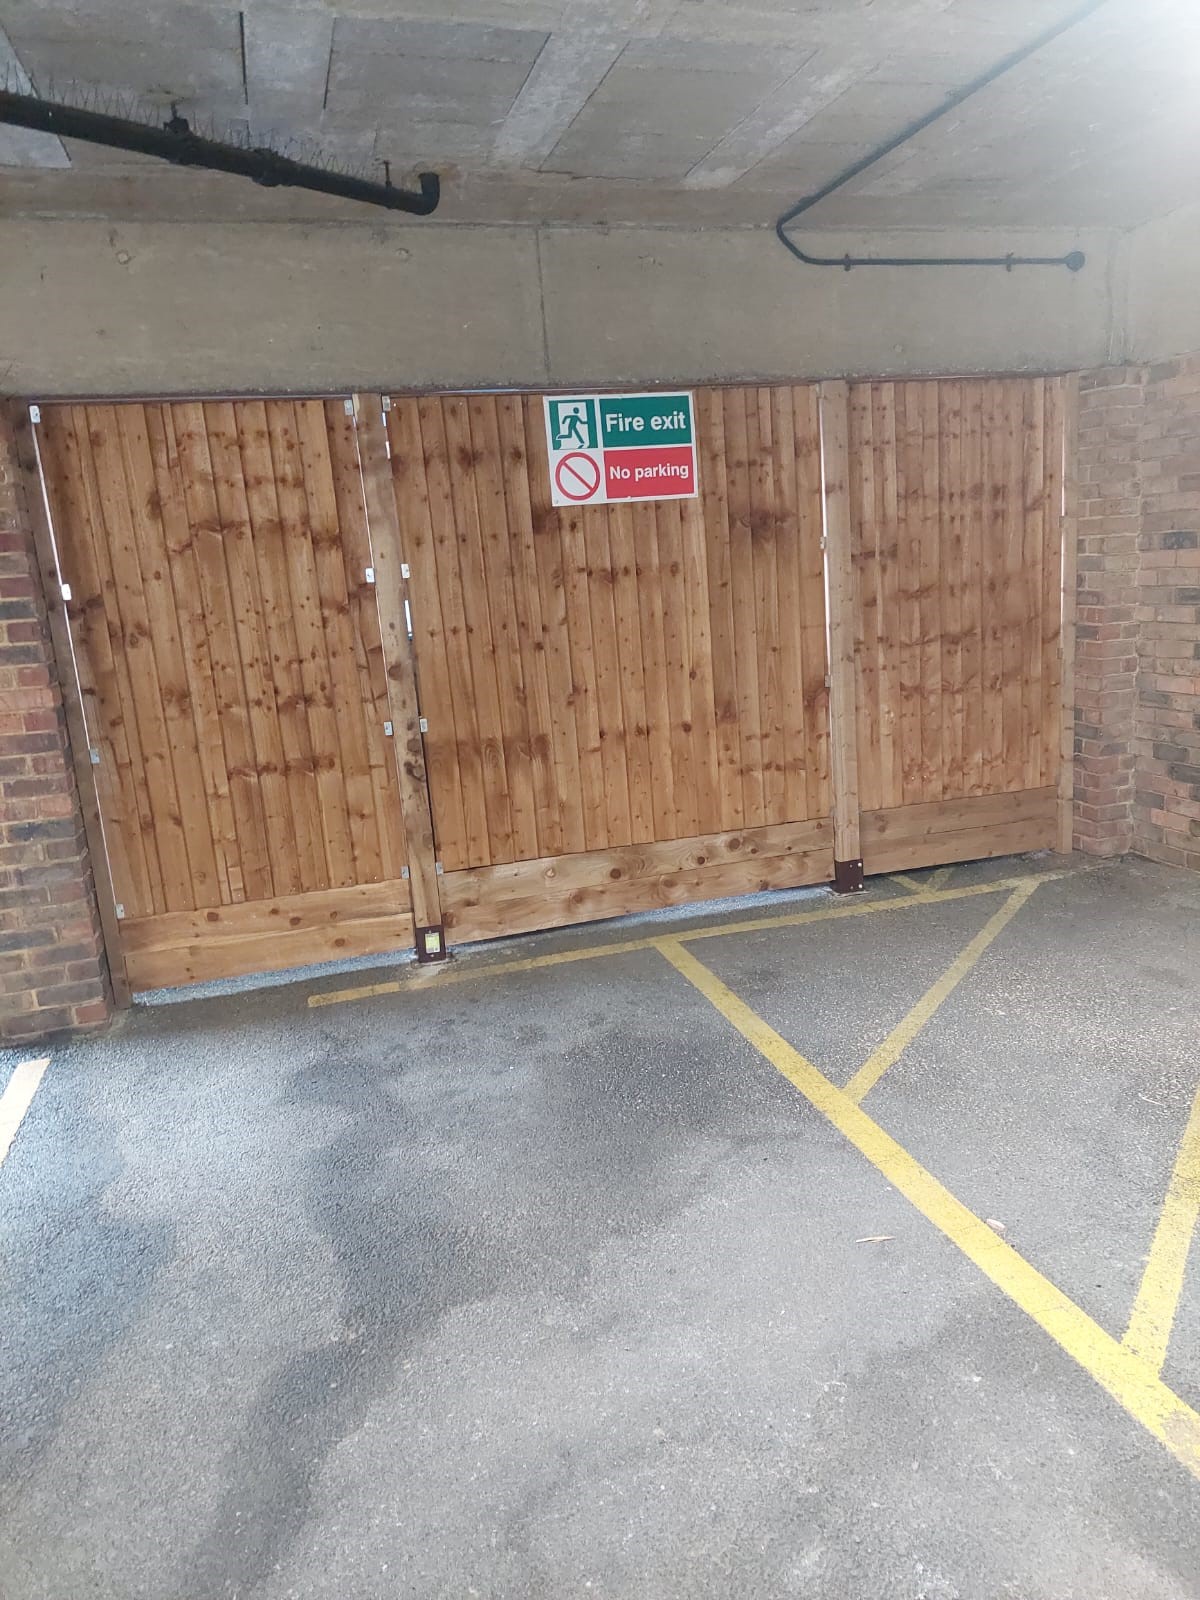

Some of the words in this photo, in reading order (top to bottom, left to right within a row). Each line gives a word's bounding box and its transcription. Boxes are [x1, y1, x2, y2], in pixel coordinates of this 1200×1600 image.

[605, 412, 645, 432] Fire
[650, 411, 686, 431] exit
[609, 465, 631, 480] No
[634, 463, 689, 482] parking
